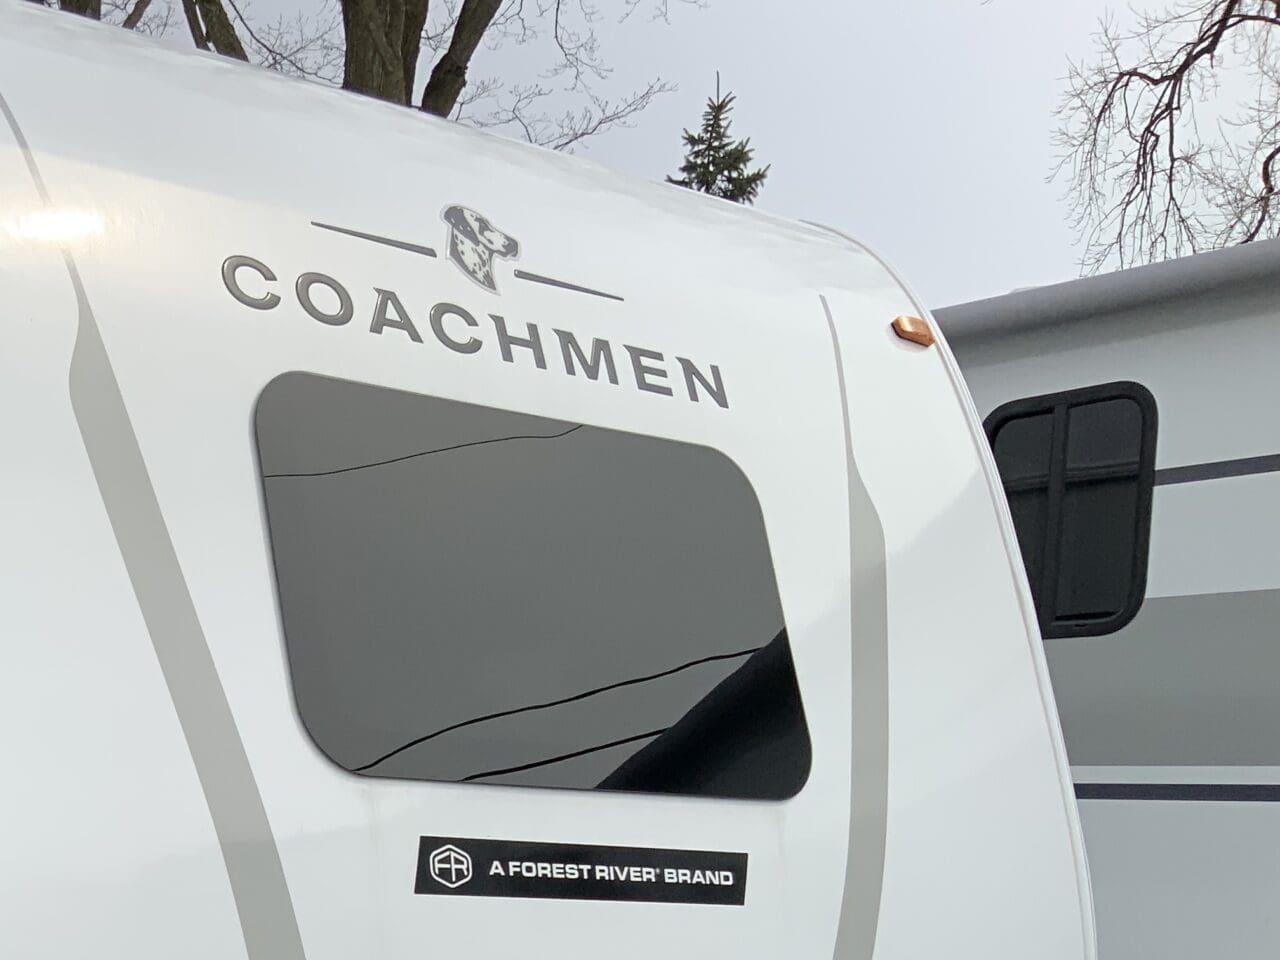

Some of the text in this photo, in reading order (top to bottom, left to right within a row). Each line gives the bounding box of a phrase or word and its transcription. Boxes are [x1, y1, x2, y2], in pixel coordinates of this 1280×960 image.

[221, 254, 730, 410] COACHMEN
[489, 860, 506, 876] A
[508, 861, 592, 880] FOREST
[664, 868, 734, 886] BRAND
